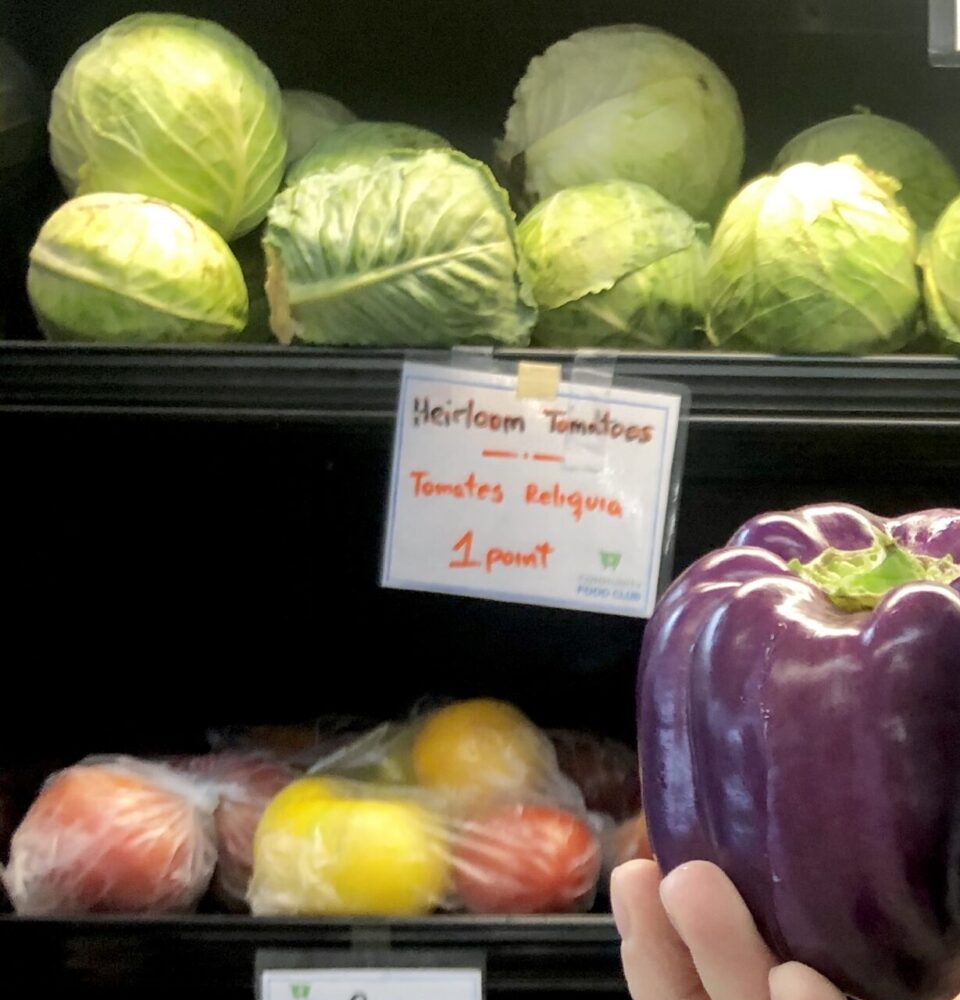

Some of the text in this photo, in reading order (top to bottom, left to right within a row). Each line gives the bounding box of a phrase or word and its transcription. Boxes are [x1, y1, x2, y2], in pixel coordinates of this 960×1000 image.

[412, 397, 654, 444] Heirloom Tomatoes
[410, 471, 623, 522] Tomates Reliquia
[449, 529, 555, 574] 1 point
